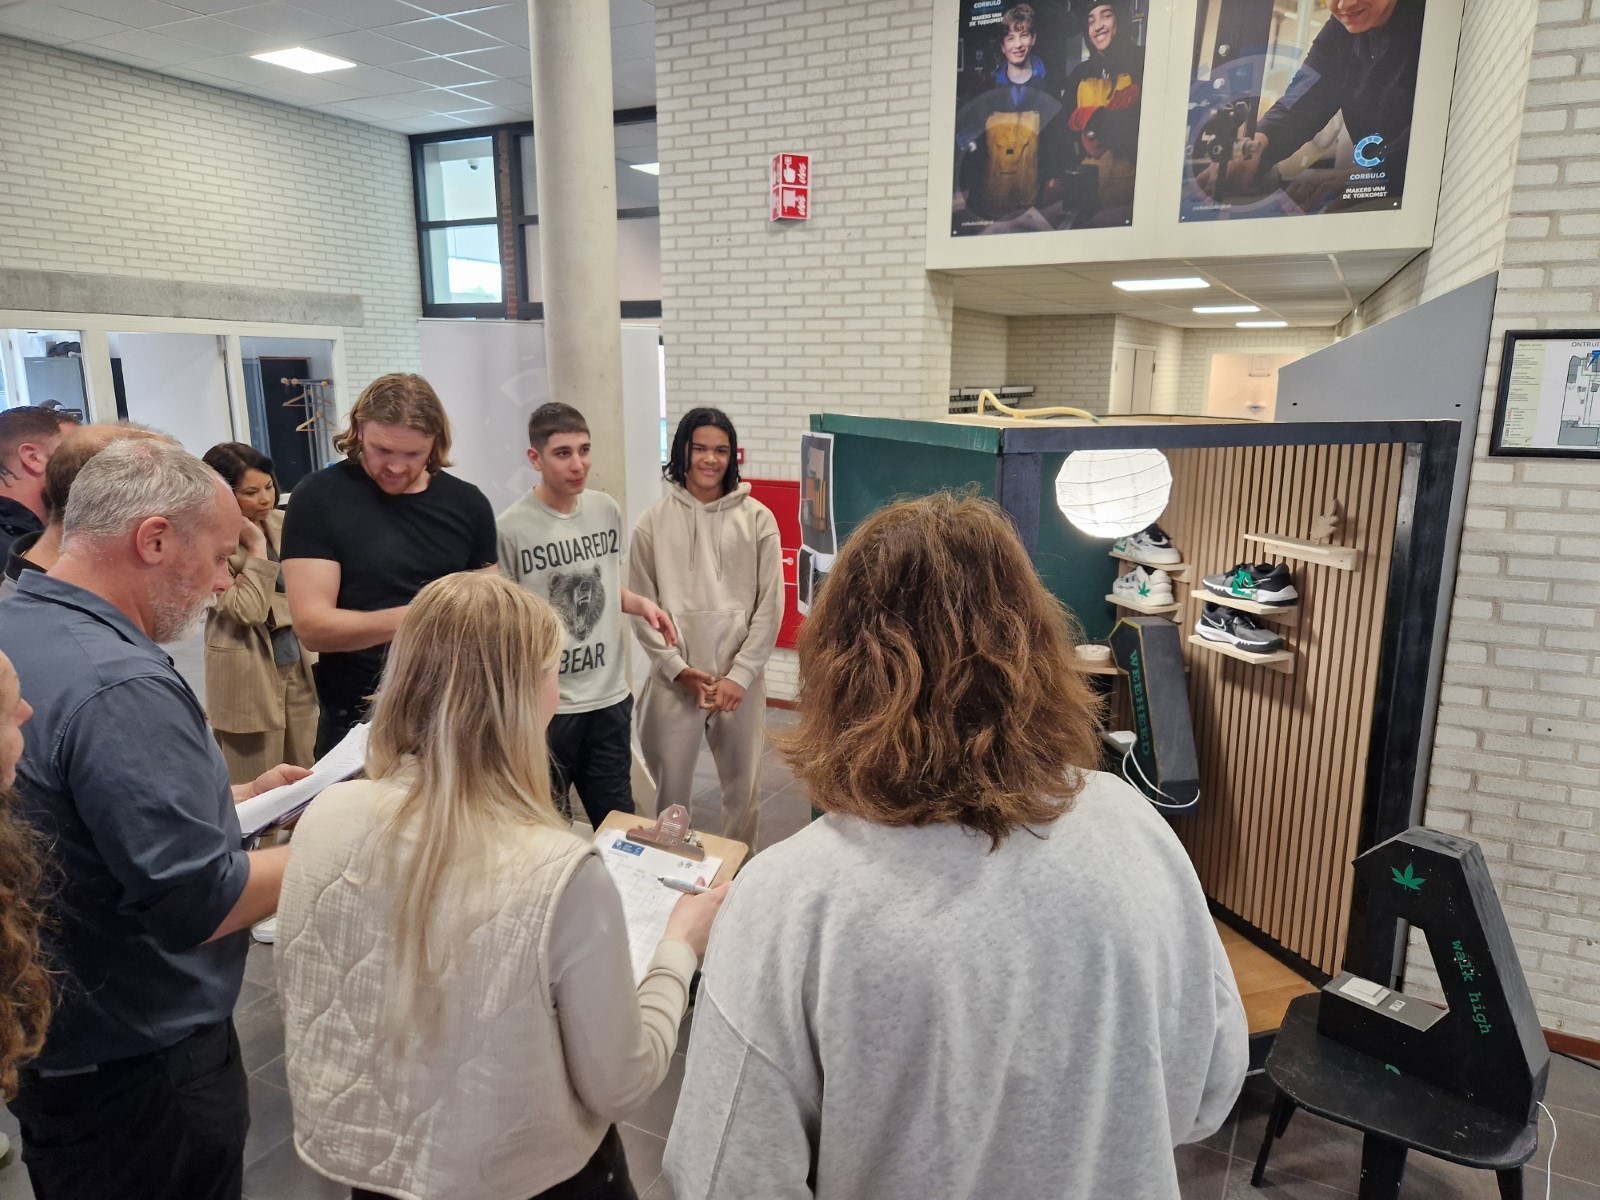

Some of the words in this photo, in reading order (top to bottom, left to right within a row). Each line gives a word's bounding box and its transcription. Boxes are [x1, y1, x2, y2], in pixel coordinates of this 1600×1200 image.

[1349, 172, 1386, 180] CORBULO
[1346, 186, 1372, 194] MAKERS
[1353, 191, 1388, 199] TOEKOMST
[520, 528, 619, 575] DSQUARED2
[558, 642, 606, 675] BEAR
[1451, 939, 1475, 982] walk
[1468, 991, 1492, 1035] high
